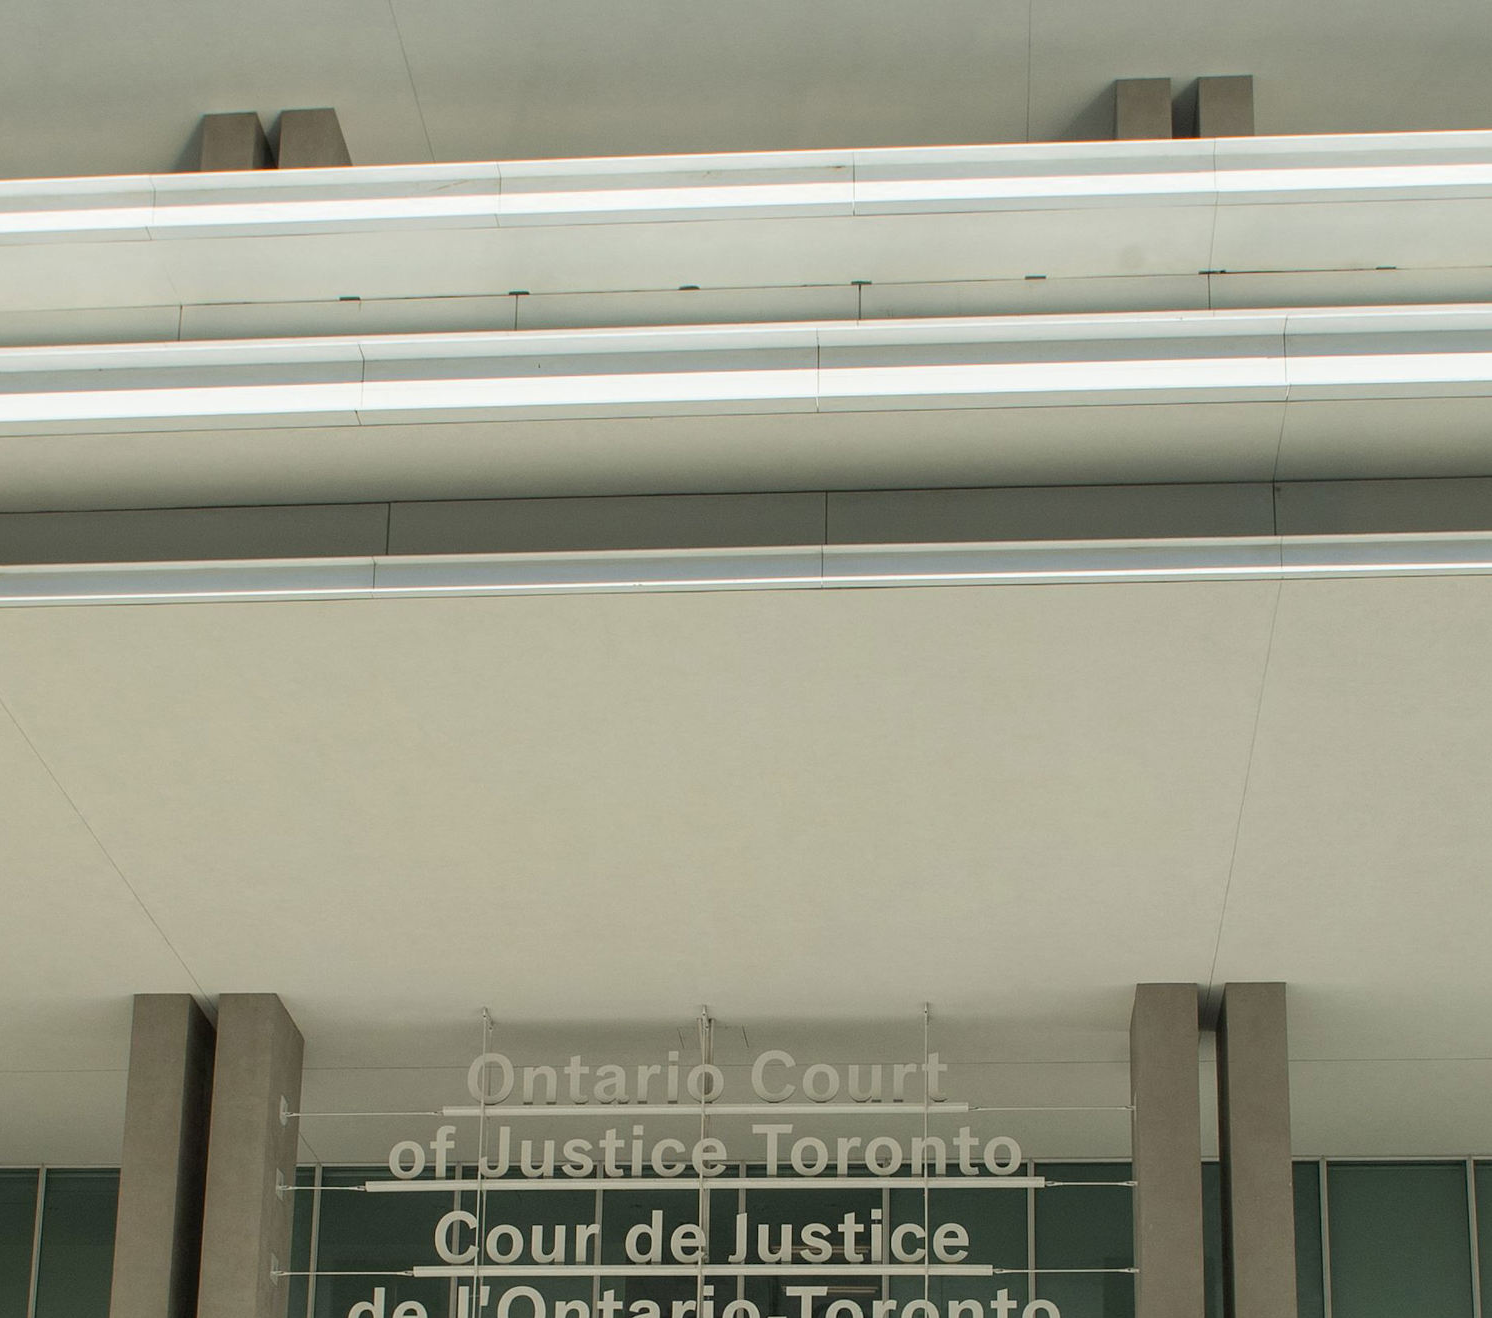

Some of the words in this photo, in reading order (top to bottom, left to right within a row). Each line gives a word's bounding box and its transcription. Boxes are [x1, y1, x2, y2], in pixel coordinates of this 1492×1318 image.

[468, 1050, 725, 1105] Ontario
[751, 1049, 948, 1103] Court
[389, 1125, 456, 1178] of
[480, 1125, 728, 1178] Justice
[754, 1124, 1023, 1176] Toronto
[434, 1209, 600, 1264] Cour
[625, 1209, 706, 1264] de
[728, 1207, 970, 1263] Justice
